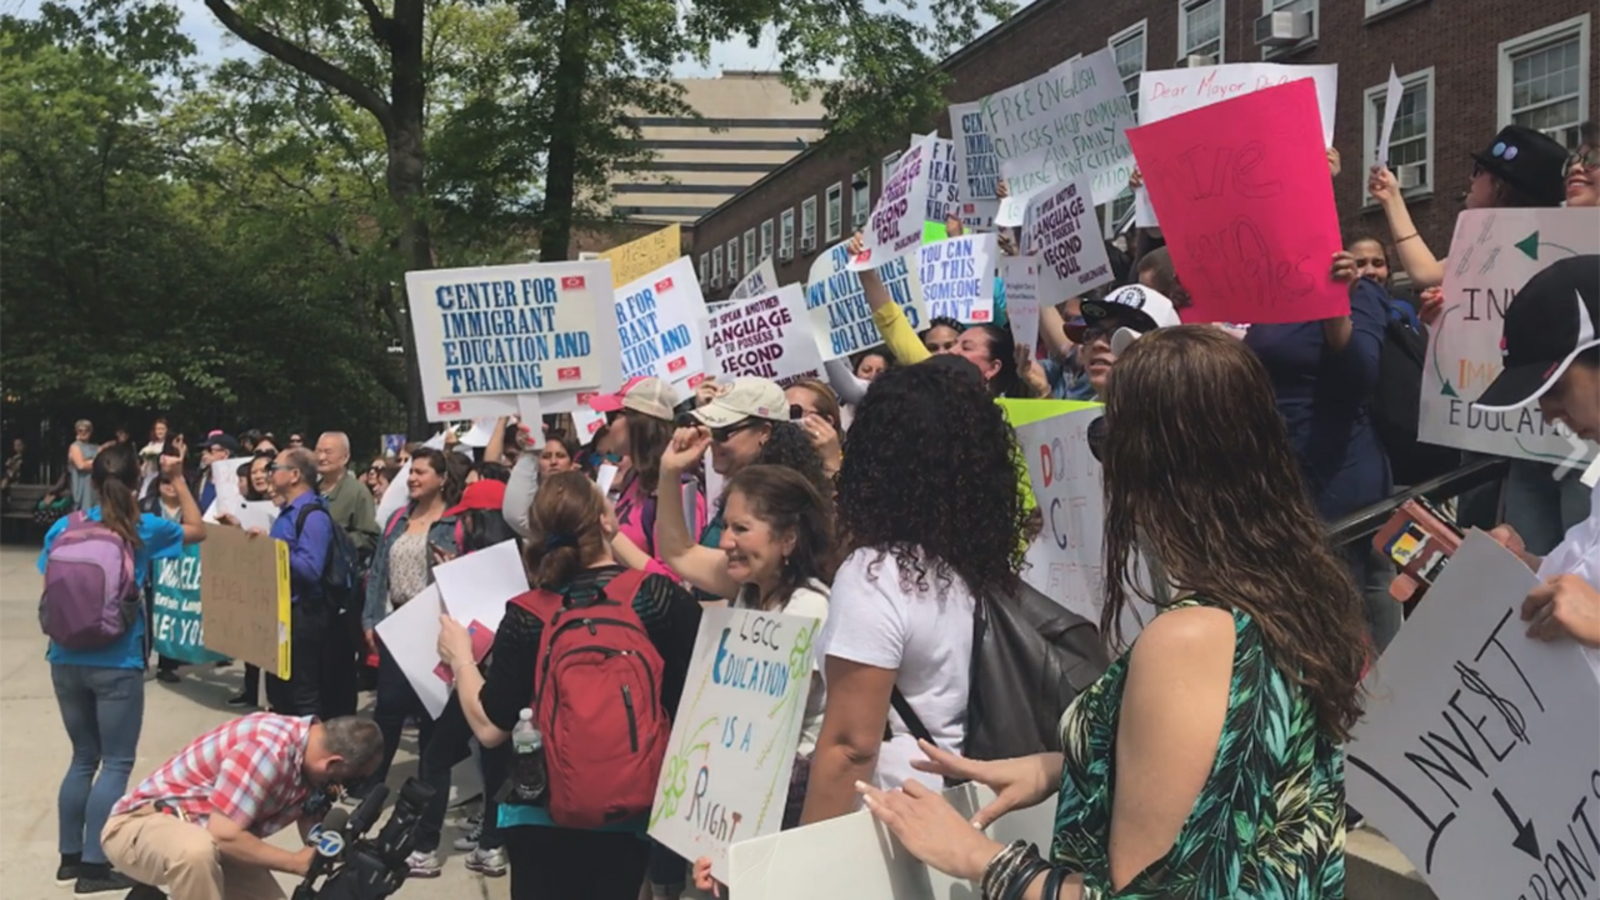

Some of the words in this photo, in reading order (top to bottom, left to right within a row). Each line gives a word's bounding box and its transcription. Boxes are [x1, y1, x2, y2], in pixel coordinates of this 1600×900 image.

[985, 88, 1035, 134] FREE
[1037, 67, 1097, 111] ENGLISH
[1150, 81, 1187, 102] Dear
[1197, 69, 1245, 98] Mayor
[994, 124, 1054, 160] CLASSES
[1072, 120, 1115, 156] FAMILY
[877, 219, 900, 246] SOUL
[1032, 196, 1085, 241] LANGUAGE
[921, 243, 942, 265] YOU
[946, 238, 974, 259] CAN
[1043, 234, 1082, 267] SECOND
[941, 257, 975, 280] THIS
[1055, 256, 1082, 280] SOUL
[435, 279, 519, 311] CENTER
[520, 277, 558, 305] FOR
[626, 288, 657, 319] FOR
[923, 278, 980, 302] SOMEONE
[441, 305, 556, 340] IMMIGRANT
[720, 308, 743, 326] SPEAK
[745, 295, 780, 317] ANOTHER
[931, 299, 974, 320] CAN'T
[660, 323, 692, 356] AND
[705, 307, 792, 350] LANGUAGE
[737, 329, 775, 350] POSSESS
[829, 324, 859, 356] FOR
[442, 334, 550, 367] EDUCATION
[554, 331, 591, 359] AND
[721, 342, 784, 374] SECOND
[445, 363, 544, 394] TRAINING
[721, 715, 738, 748] IS
[739, 722, 752, 753] A
